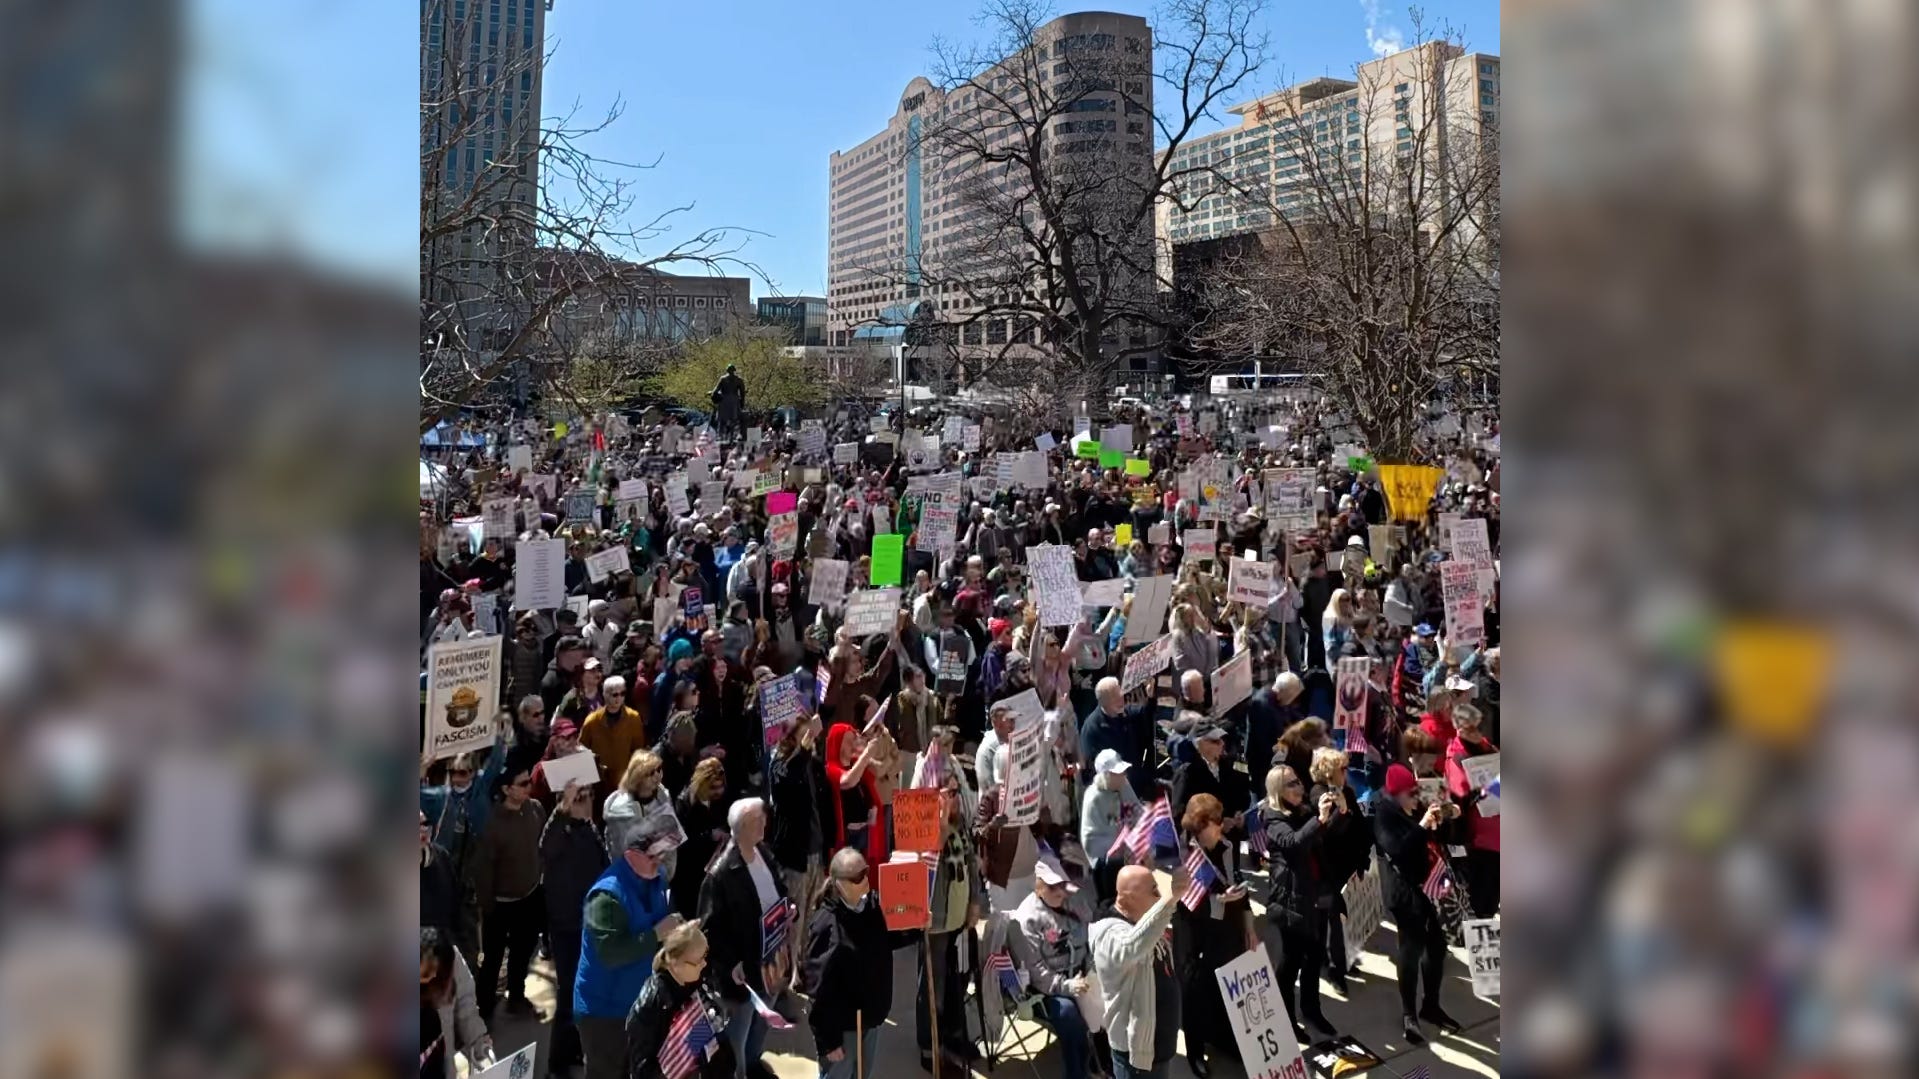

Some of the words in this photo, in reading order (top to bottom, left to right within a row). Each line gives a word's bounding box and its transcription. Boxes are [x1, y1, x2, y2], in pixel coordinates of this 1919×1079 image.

[924, 492, 942, 503] NO
[437, 662, 465, 678] ONLY
[468, 660, 490, 673] YOU
[435, 725, 487, 744] FASCISM
[896, 812, 911, 824] NO
[897, 828, 910, 839] NO
[897, 872, 909, 881] ICE
[1222, 965, 1271, 1001] Wrong
[1236, 986, 1275, 1034] ICE
[1257, 1028, 1279, 1063] IS
